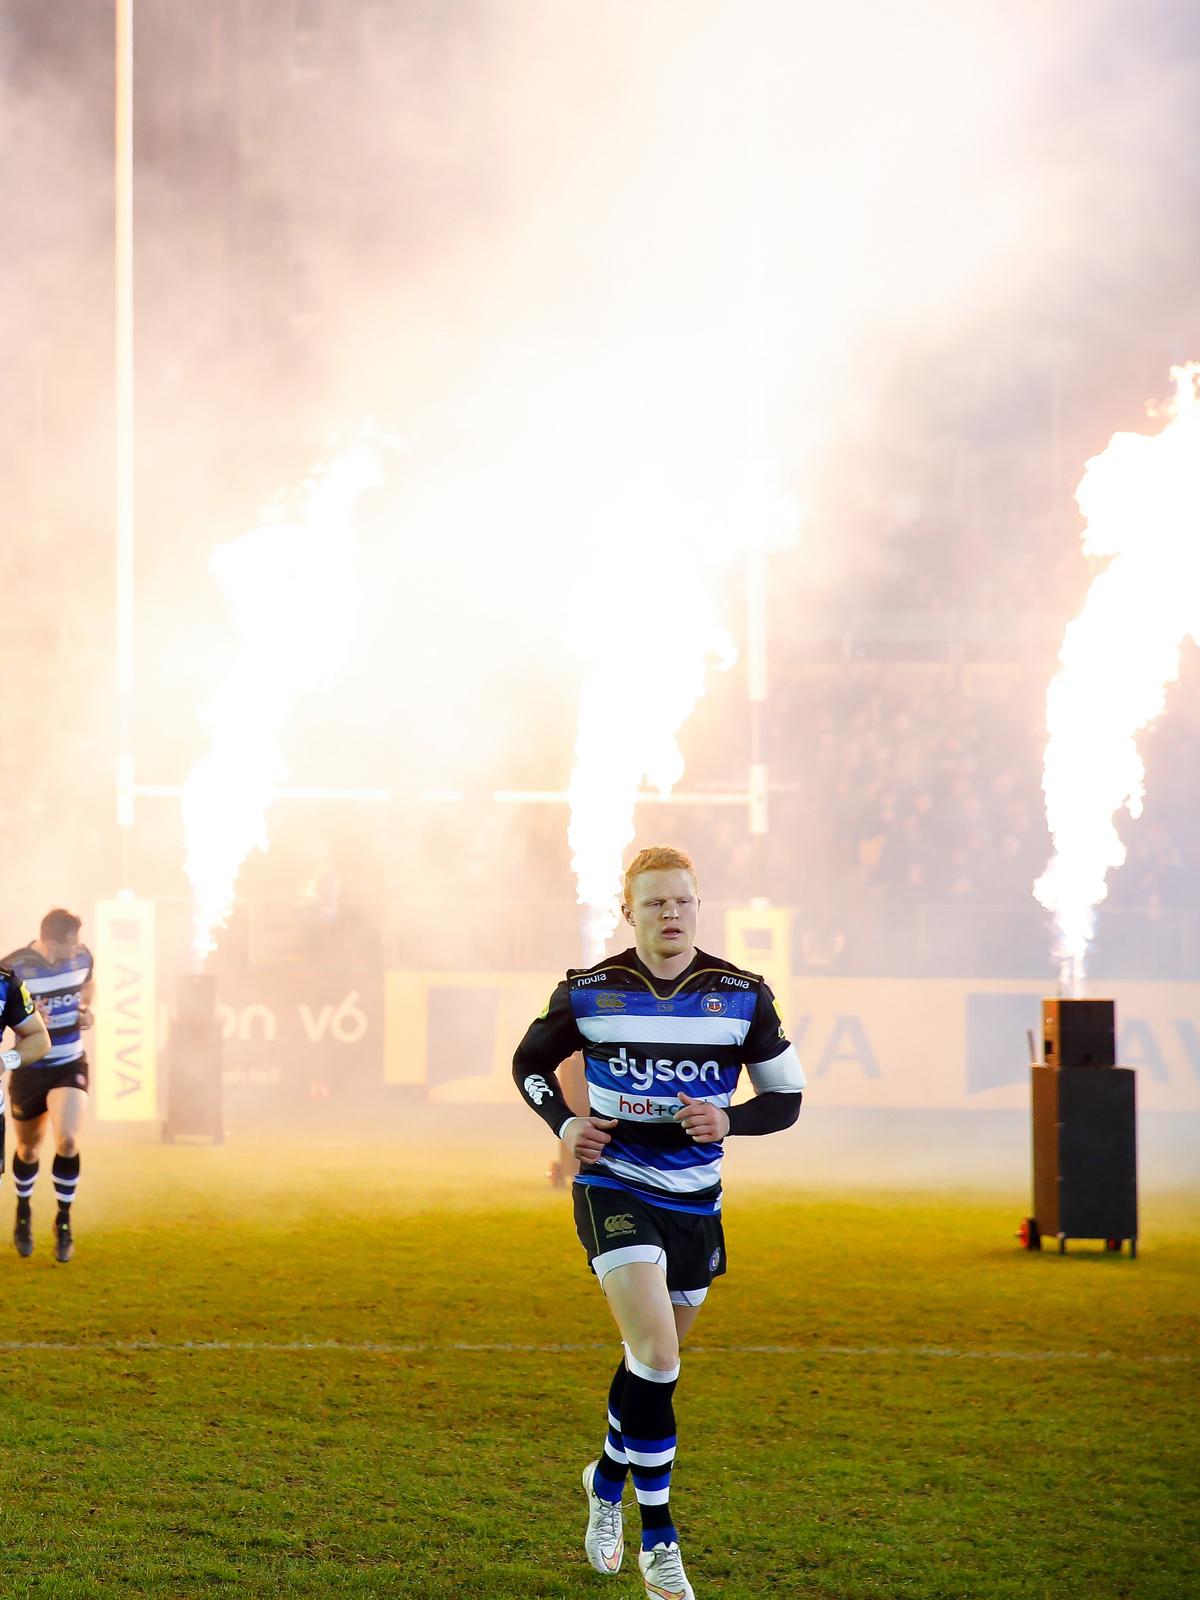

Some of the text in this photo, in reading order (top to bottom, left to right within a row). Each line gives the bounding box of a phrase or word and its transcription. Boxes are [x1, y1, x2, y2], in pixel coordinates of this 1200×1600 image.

[577, 973, 607, 987] novia
[720, 976, 750, 989] novia
[37, 991, 82, 1016] yson
[298, 989, 369, 1044] v6
[114, 963, 143, 1099] AVIVA
[608, 1048, 720, 1091] dyson
[619, 1095, 707, 1117] hot+c
